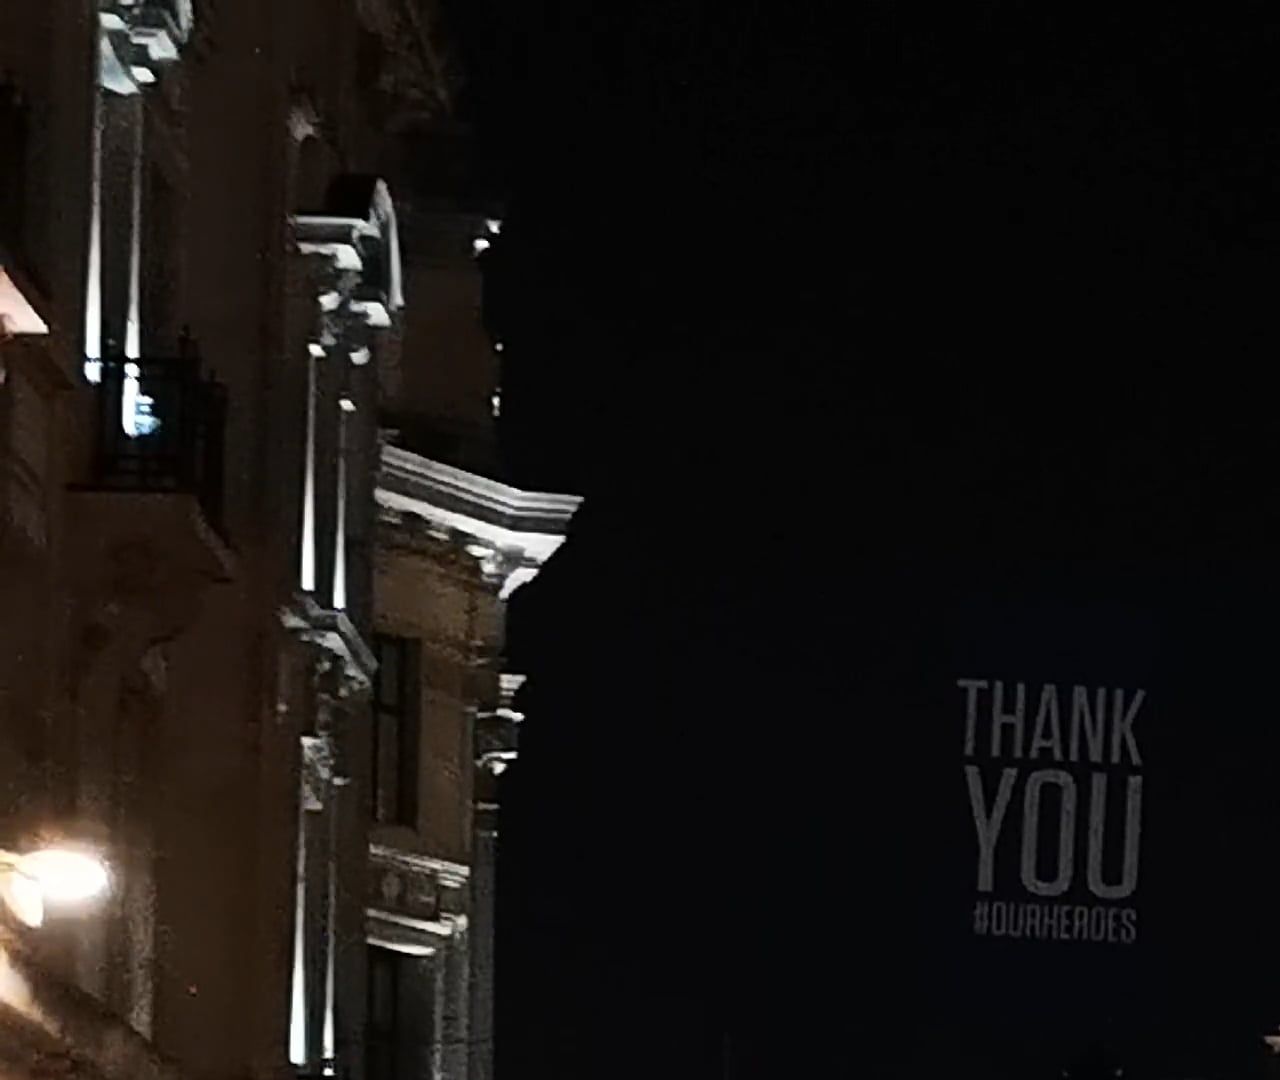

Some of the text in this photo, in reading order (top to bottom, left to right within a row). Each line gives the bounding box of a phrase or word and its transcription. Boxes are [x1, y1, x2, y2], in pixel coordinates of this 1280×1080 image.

[957, 678, 1147, 767] THANK
[964, 764, 1144, 900] YOU
[973, 900, 1138, 944] #OURHEROES
